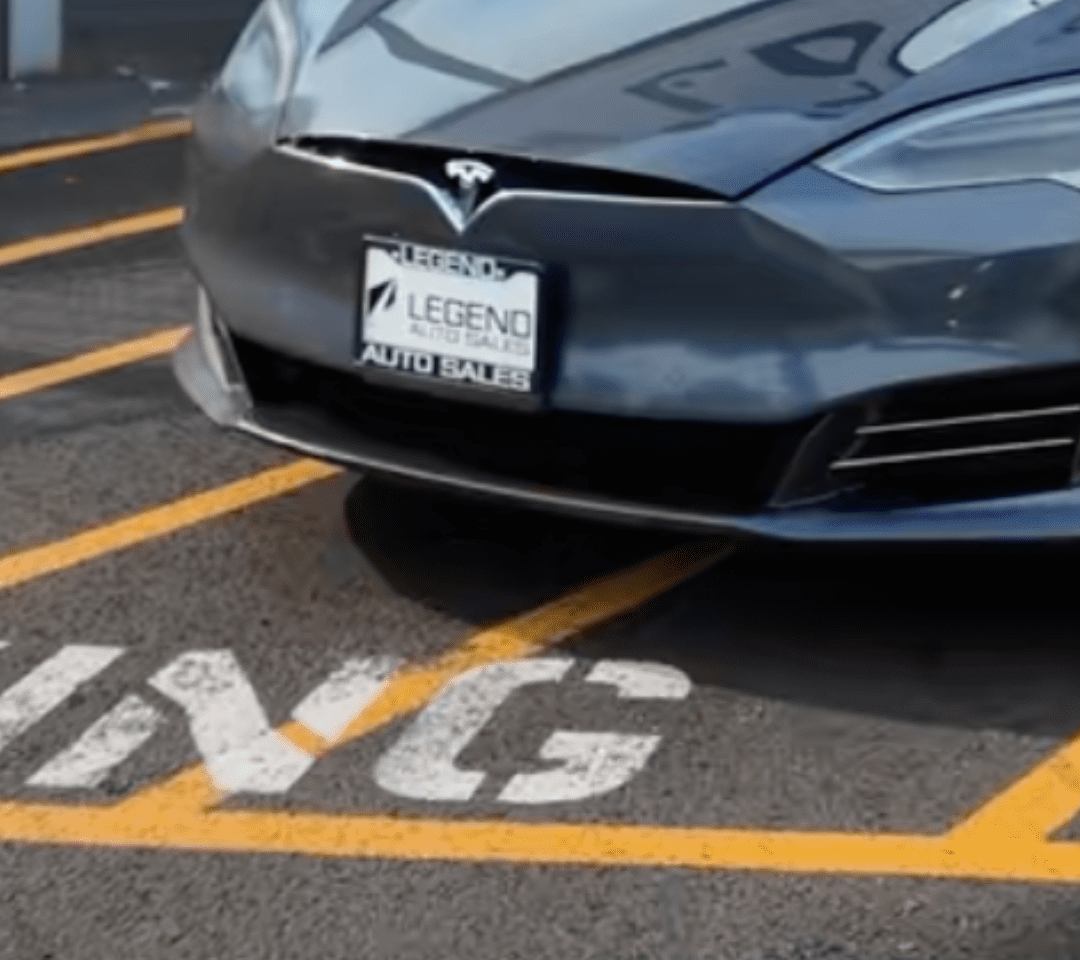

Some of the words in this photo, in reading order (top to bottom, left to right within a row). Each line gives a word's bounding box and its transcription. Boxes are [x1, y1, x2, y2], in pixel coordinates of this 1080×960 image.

[401, 243, 495, 281] LEGEND
[407, 292, 531, 340] LEGEND
[361, 343, 433, 373] AUTO
[440, 355, 531, 392] SALES
